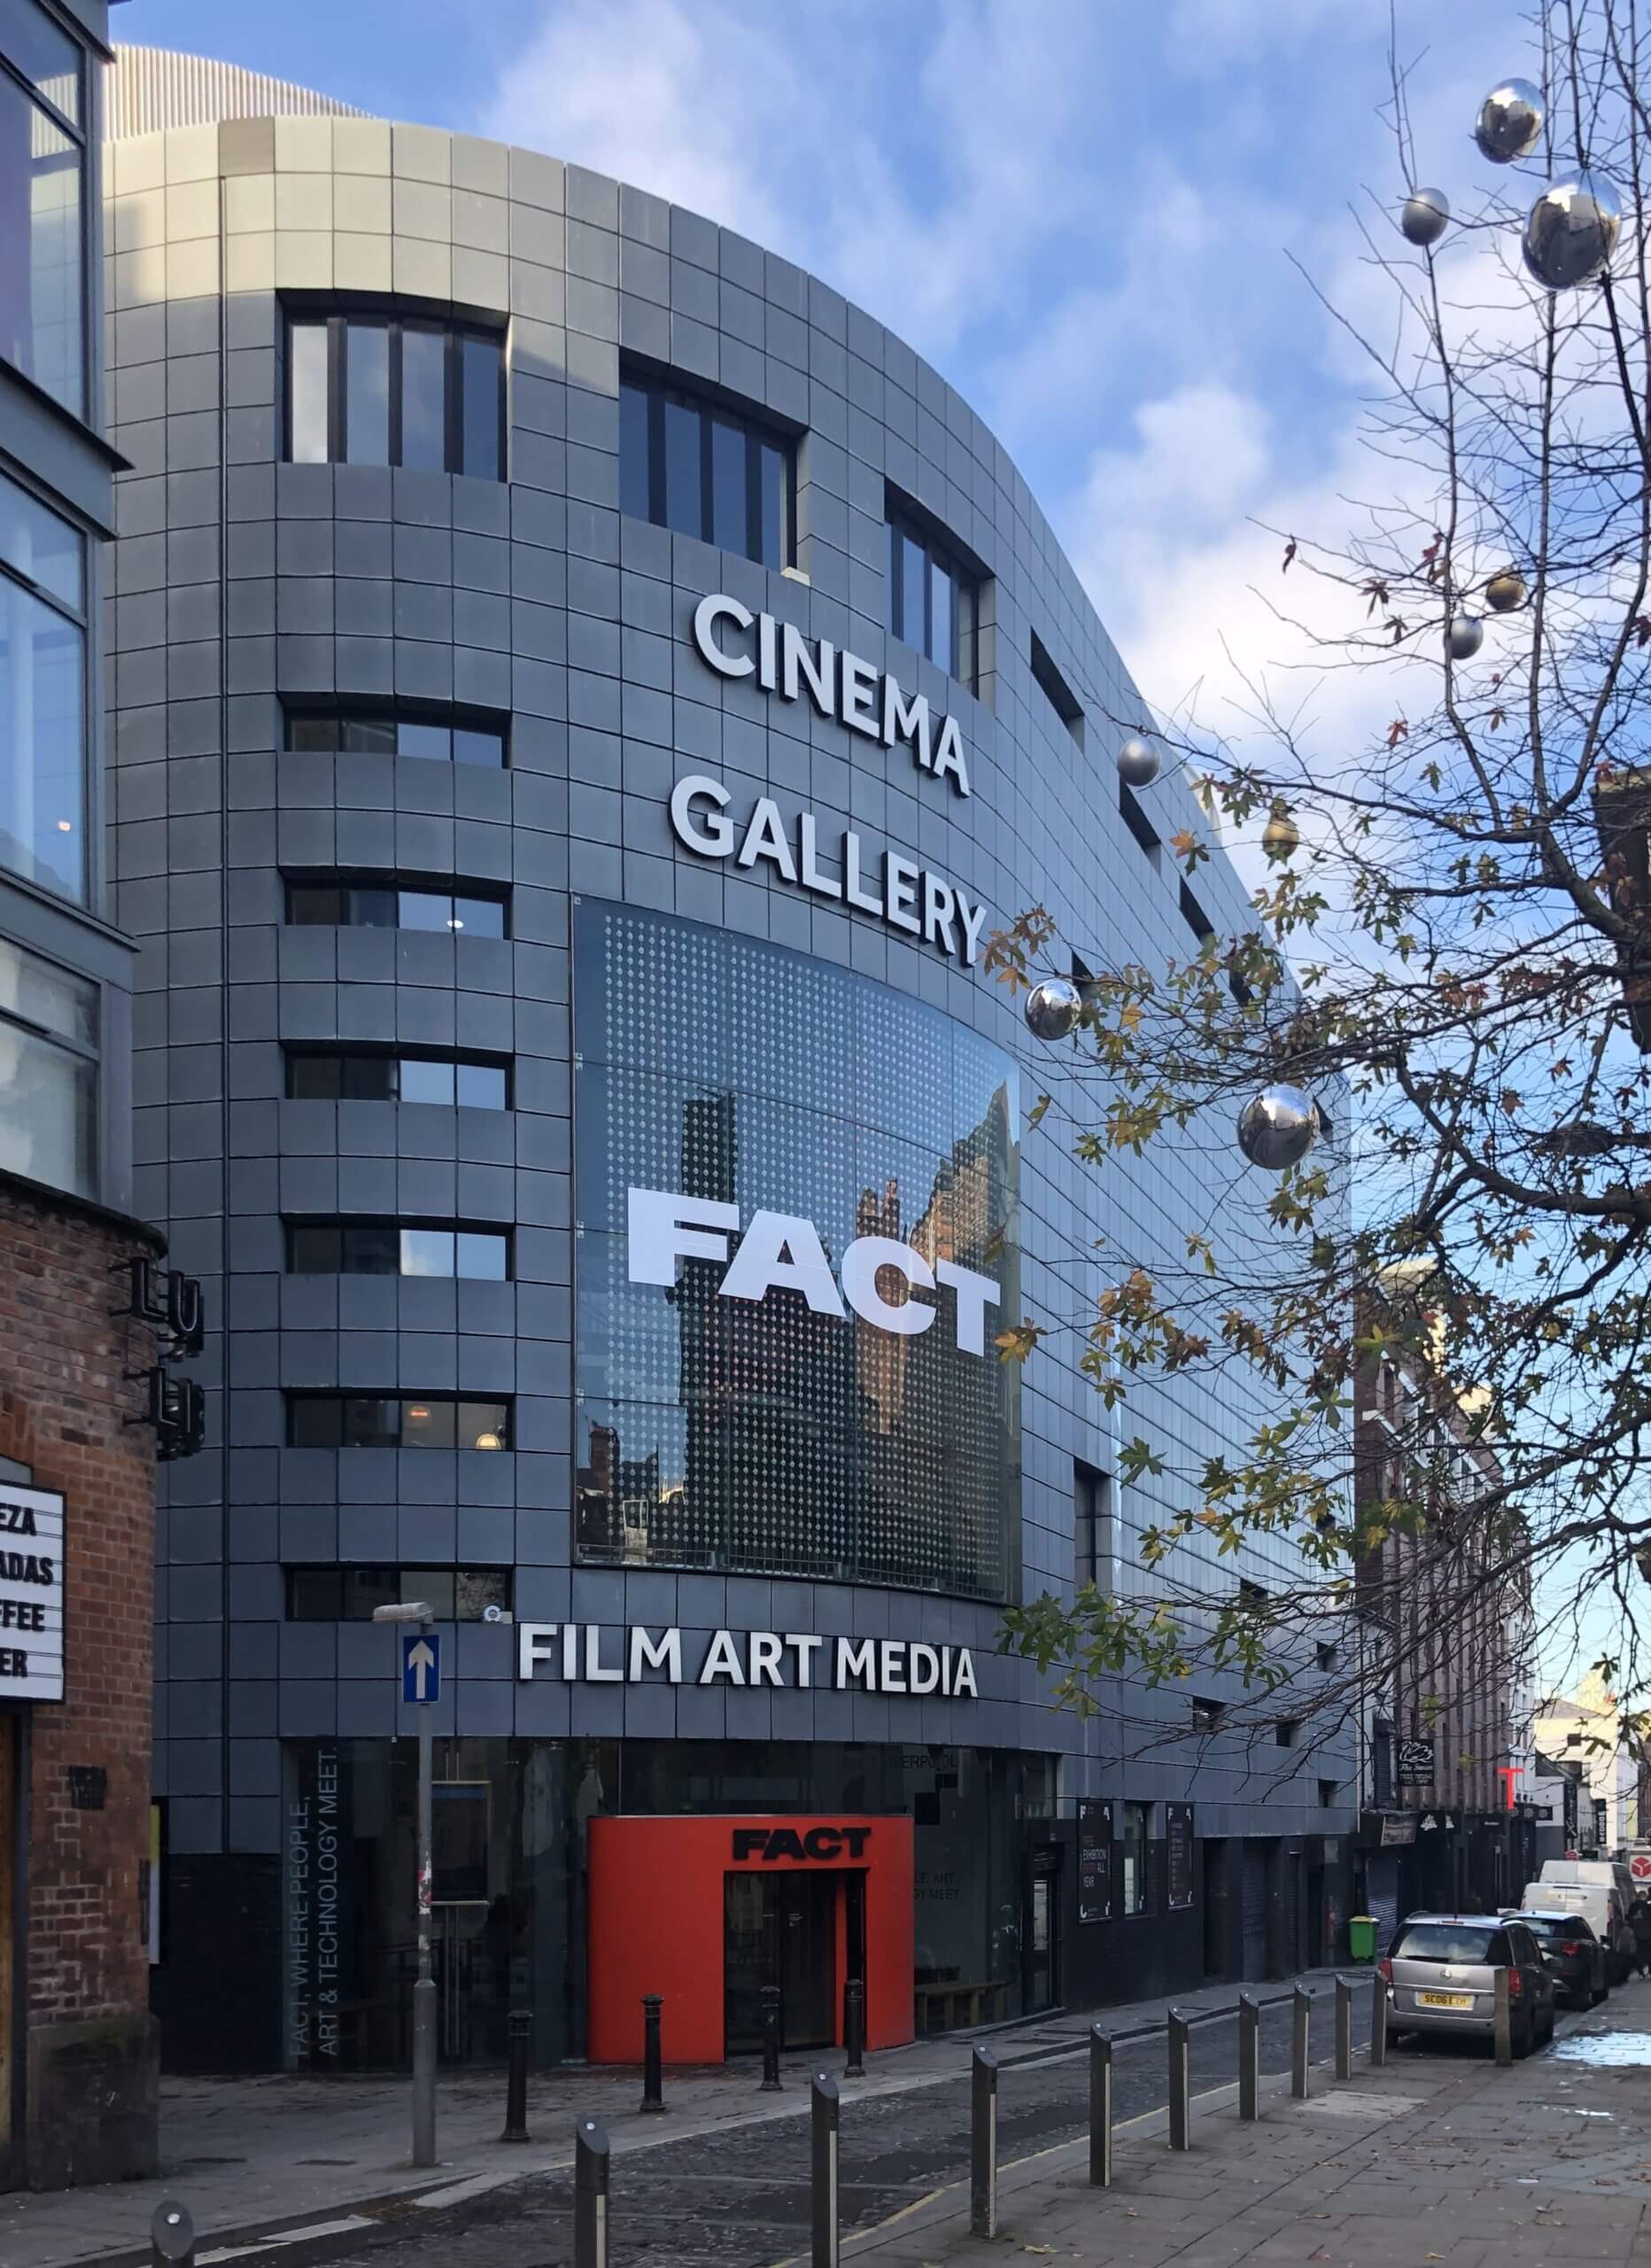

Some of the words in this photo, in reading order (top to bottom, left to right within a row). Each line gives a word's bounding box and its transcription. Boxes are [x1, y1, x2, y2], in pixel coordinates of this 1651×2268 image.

[695, 594, 970, 797] CINEMA
[670, 774, 987, 967] GALLERY
[628, 1187, 1000, 1357] FACT
[0, 1599, 45, 1632] FEE
[519, 1622, 682, 1683] FILM
[699, 1630, 823, 1688] ART
[836, 1637, 979, 1698] MEDIA
[319, 1747, 337, 1814] MEET.
[290, 1797, 310, 1894] PEOPLE,
[732, 1827, 872, 1860] FACT
[319, 1821, 337, 1984] TECHNOLOGY
[290, 1901, 308, 1987] WHERE
[319, 1989, 337, 2004] &
[319, 2010, 337, 2056] ART
